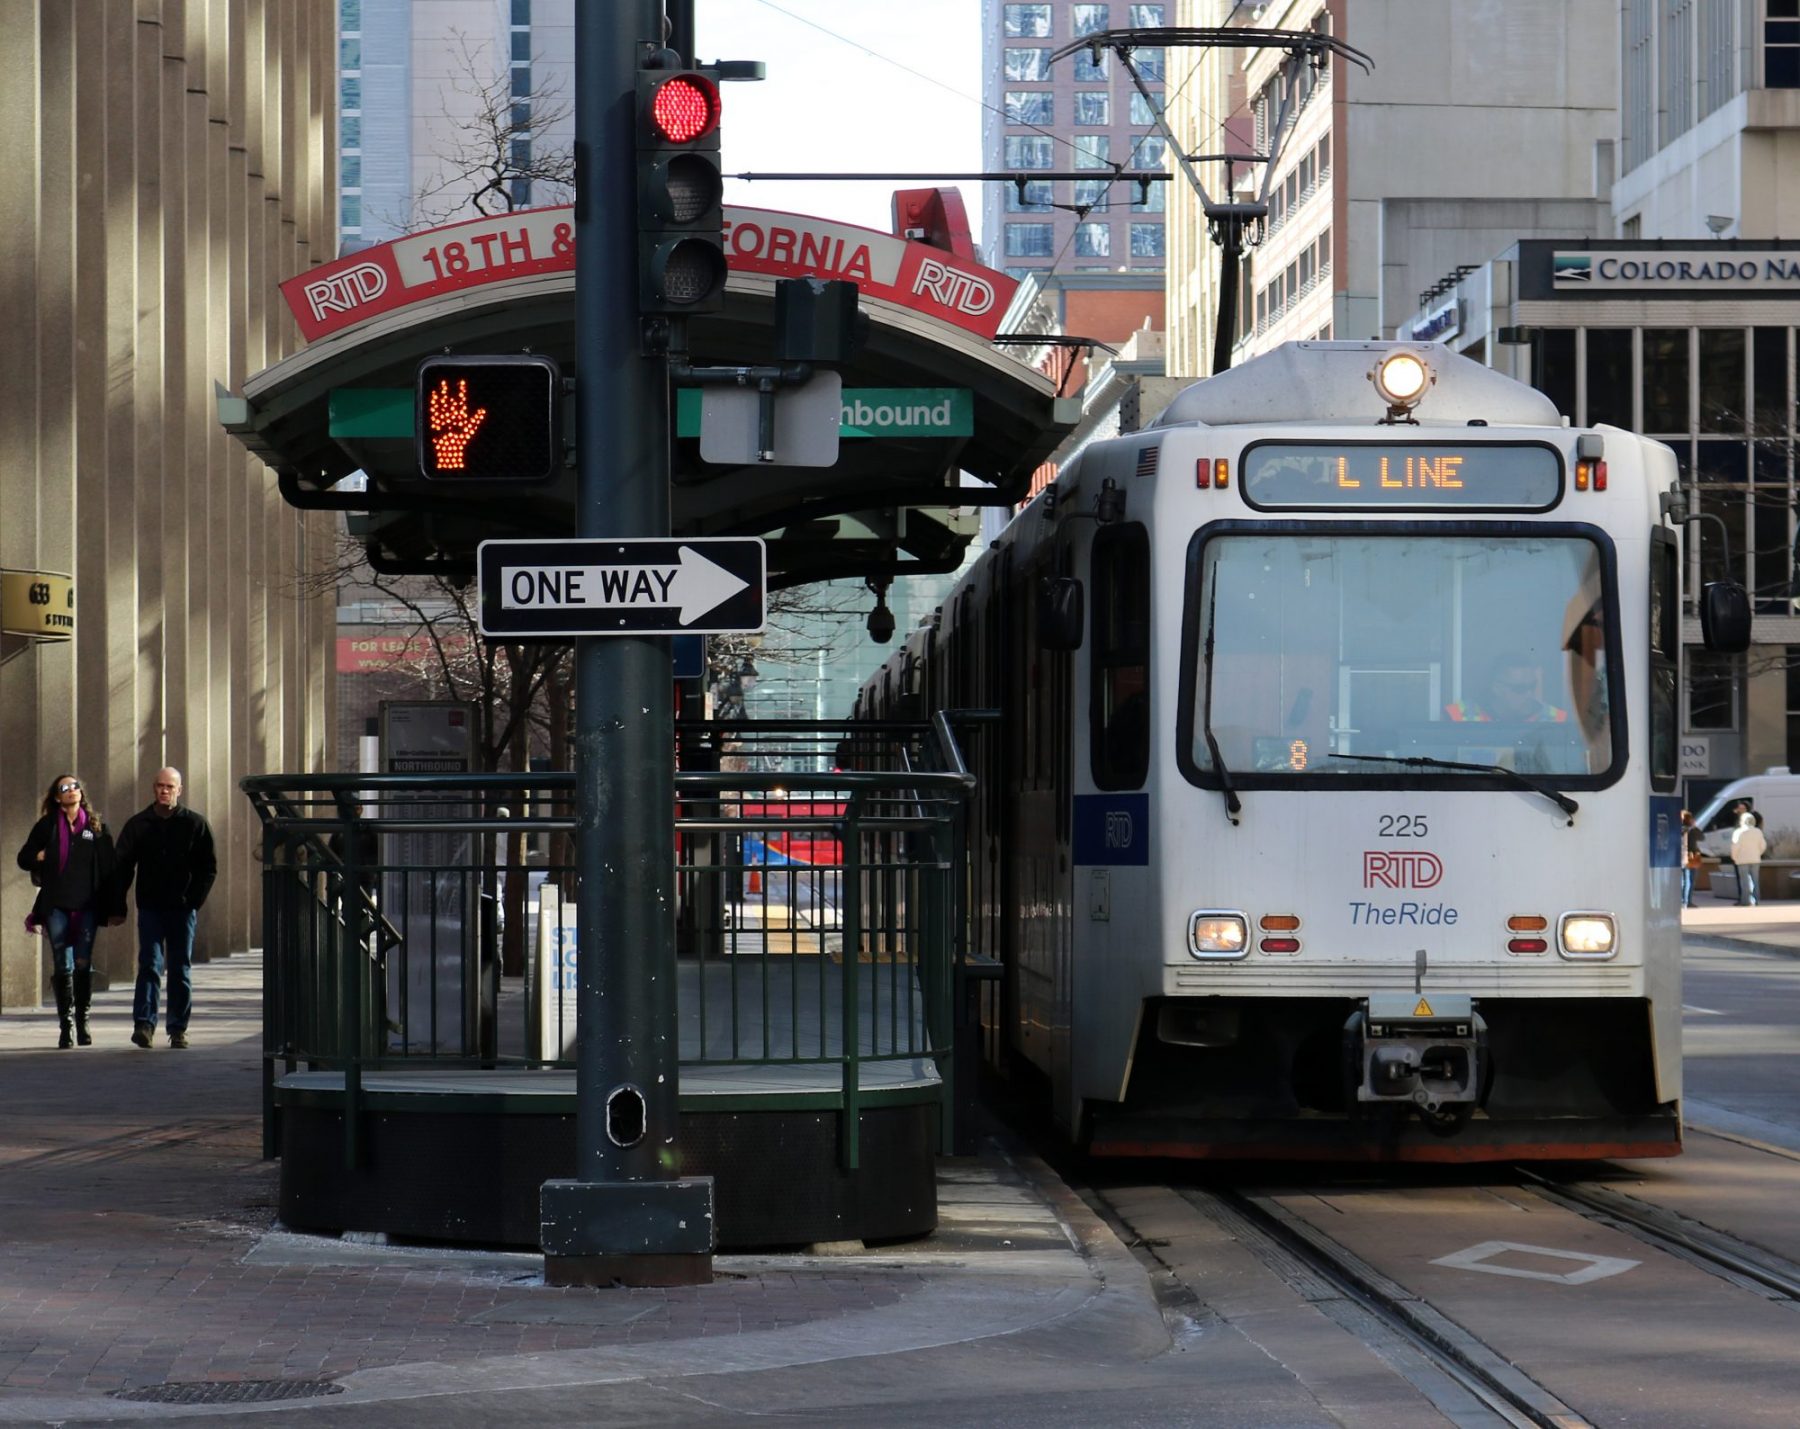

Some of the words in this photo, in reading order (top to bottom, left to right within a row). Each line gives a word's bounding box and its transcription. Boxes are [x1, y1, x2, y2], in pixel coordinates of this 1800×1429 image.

[422, 227, 534, 281] 18TH
[551, 222, 576, 259] &
[1599, 258, 1758, 281] COLORADO
[304, 262, 388, 322] RTD
[912, 257, 996, 316] RTD
[1338, 456, 1360, 488] L
[1380, 456, 1463, 488] LINE
[29, 583, 50, 605] 633
[511, 570, 586, 605] ONE
[600, 569, 679, 603] WAY
[351, 641, 378, 652] FOR
[382, 641, 422, 653] LEASE
[1290, 739, 1308, 770] 8
[1682, 745, 1705, 757] DO
[1378, 814, 1428, 838] 225
[1363, 851, 1443, 888] RTD
[1348, 902, 1459, 925] TheRide
